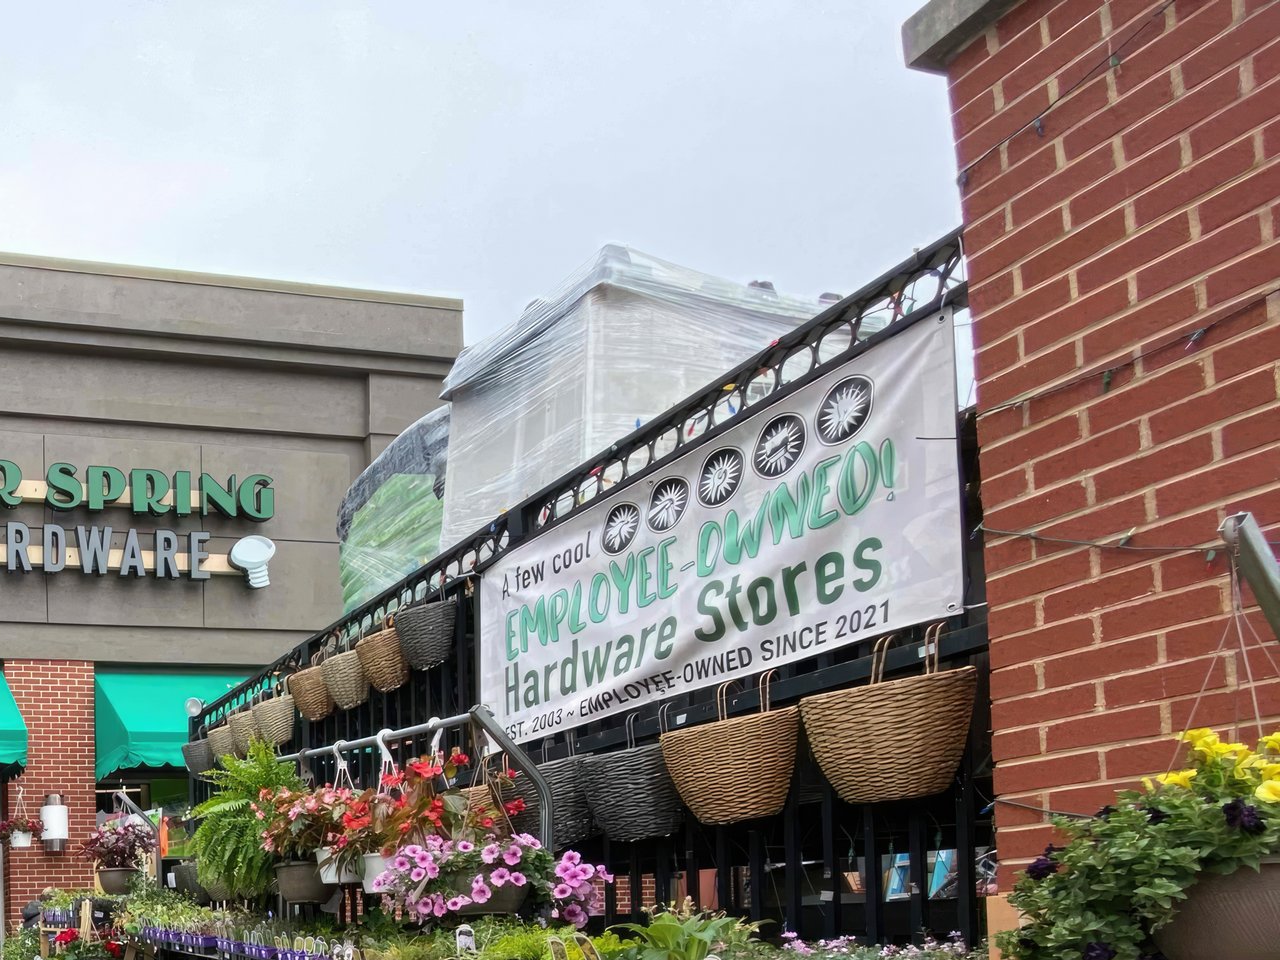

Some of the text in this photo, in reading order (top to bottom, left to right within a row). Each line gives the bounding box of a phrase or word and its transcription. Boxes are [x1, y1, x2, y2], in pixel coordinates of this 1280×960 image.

[45, 462, 275, 522] SPRING
[502, 531, 591, 600] A few cool
[505, 537, 884, 716] Hardware Stores
[532, 708, 563, 733] 2003
[580, 646, 753, 718] EMPLOYEE-OWNED
[760, 621, 828, 662] SINCE
[835, 599, 890, 639] 2021
